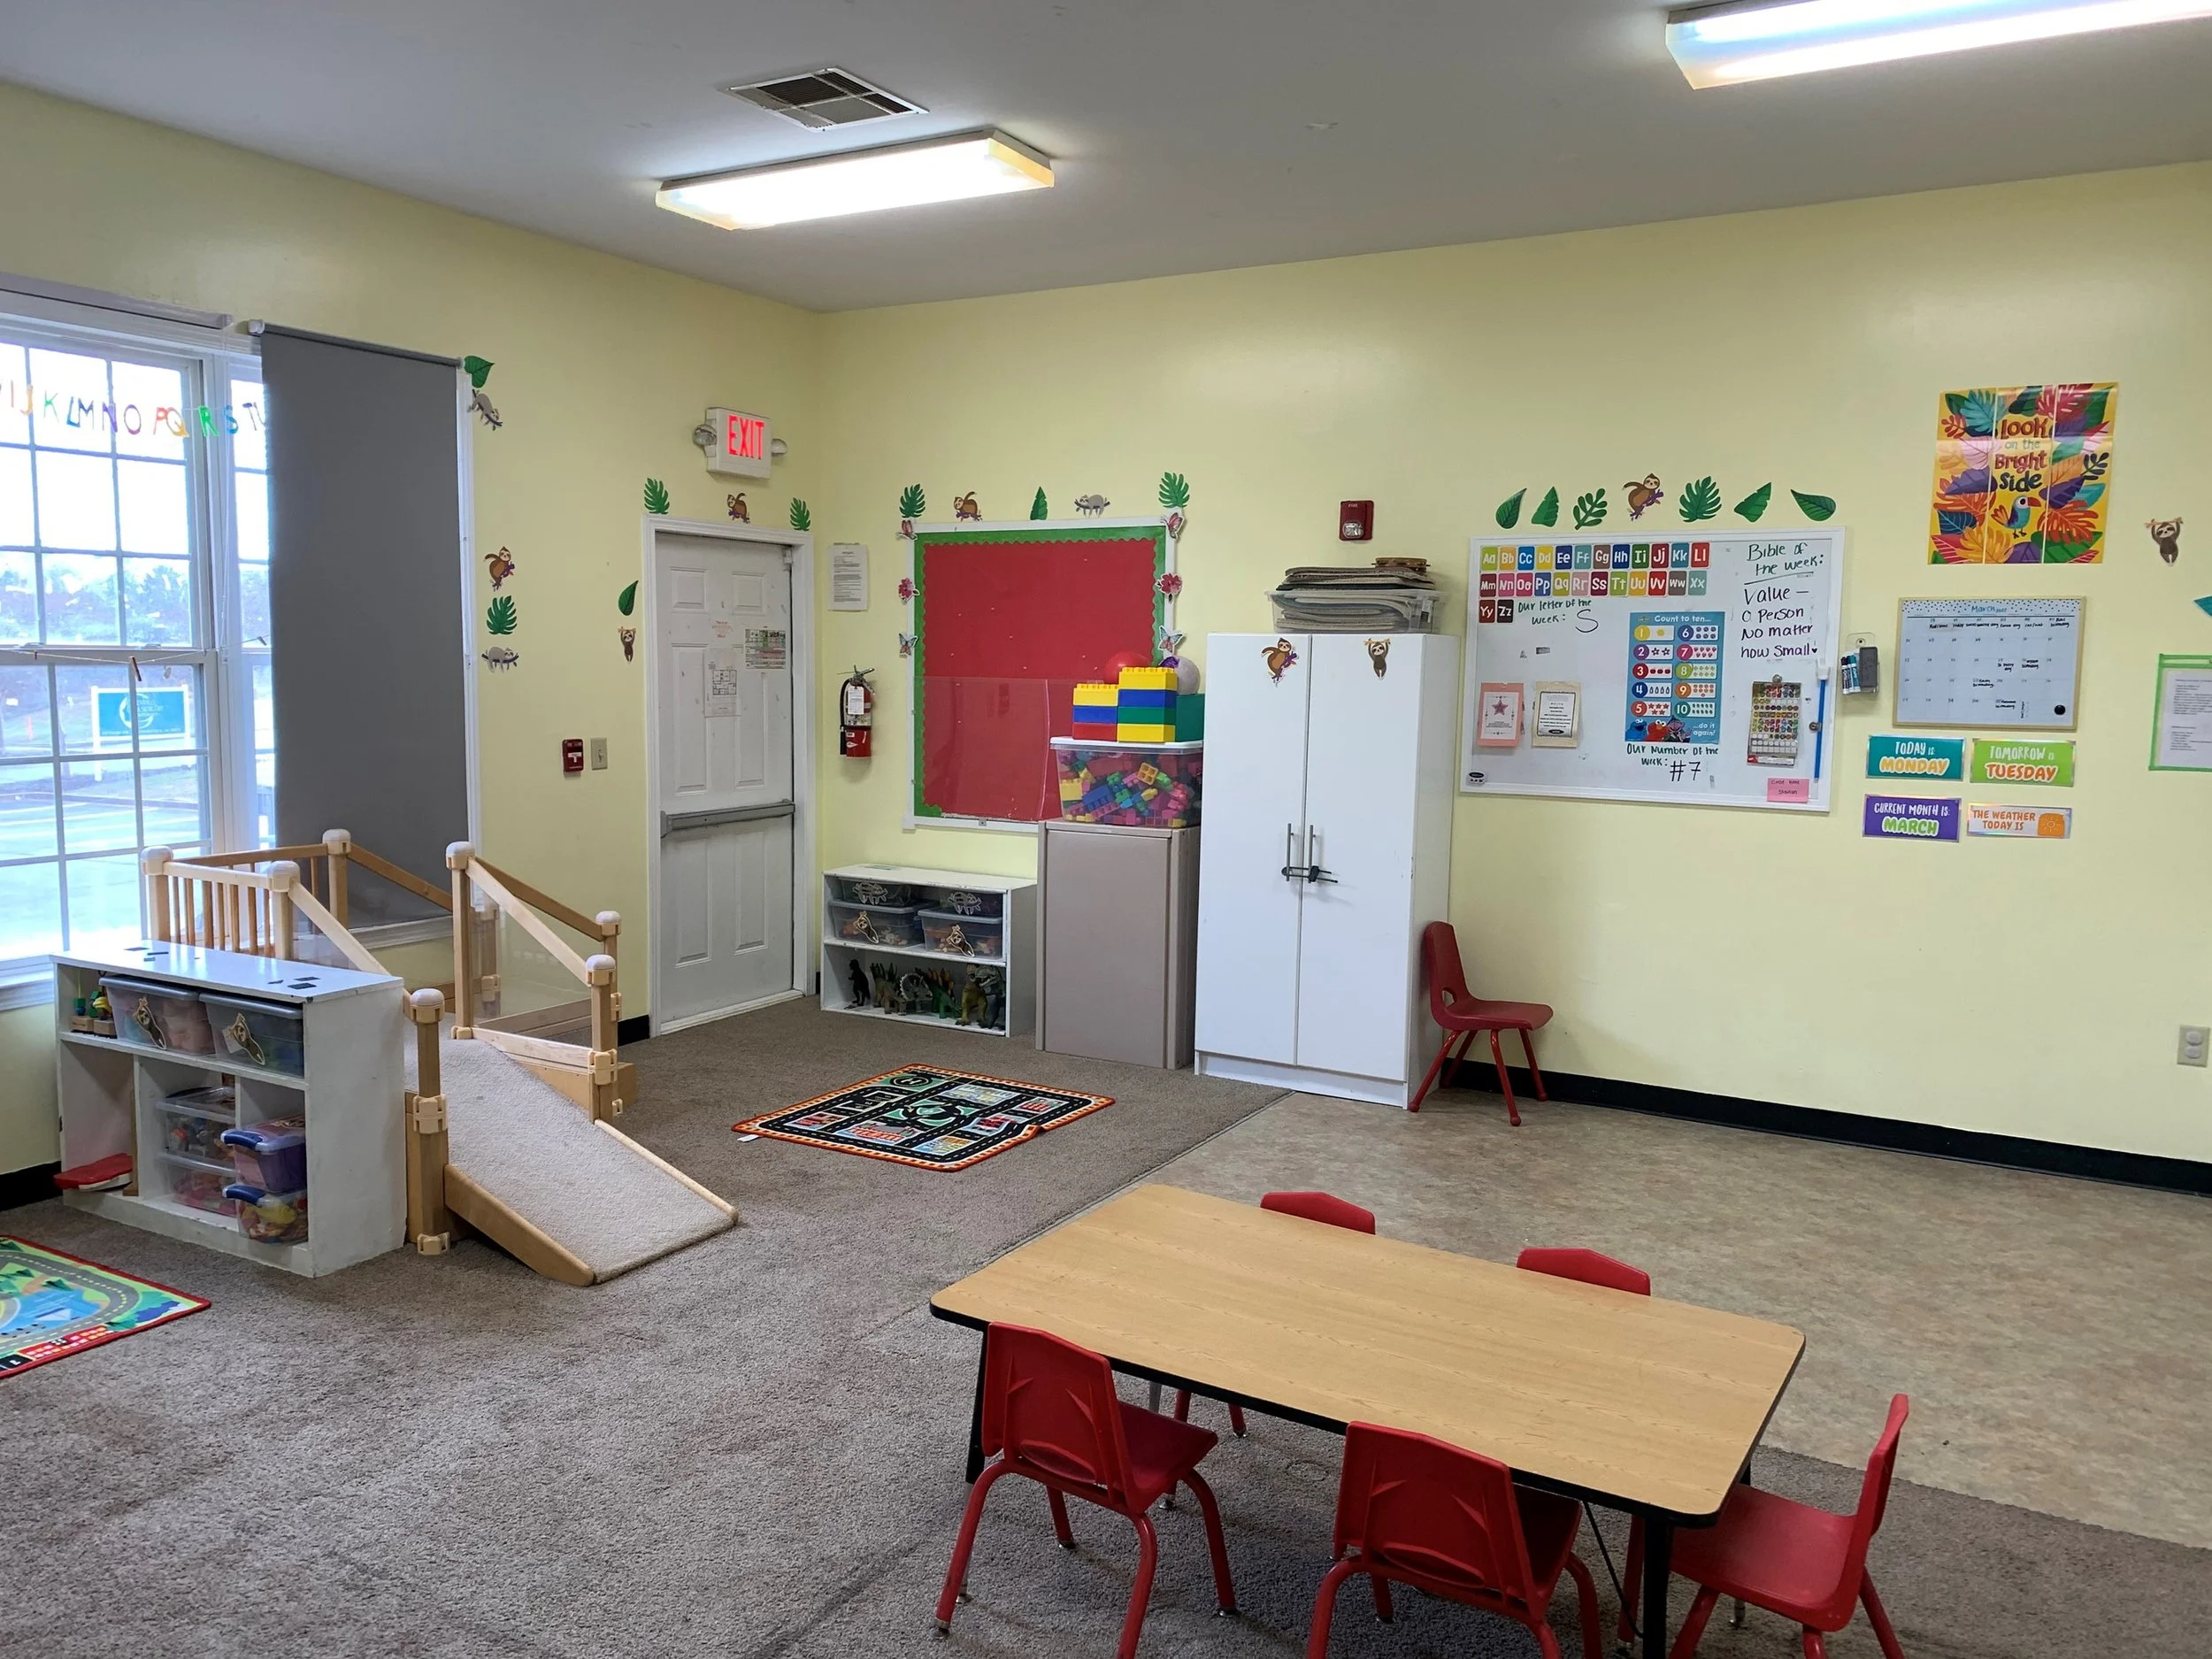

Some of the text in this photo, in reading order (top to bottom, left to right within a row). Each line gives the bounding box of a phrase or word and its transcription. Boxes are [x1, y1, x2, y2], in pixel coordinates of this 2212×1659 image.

[43, 390, 59, 423] K
[66, 396, 81, 428] L
[78, 397, 95, 430] M
[102, 402, 119, 434] N
[123, 404, 142, 435] O
[153, 407, 168, 435] P
[165, 407, 190, 438] Q
[197, 405, 219, 437] R
[223, 404, 239, 434] S
[2001, 418, 2048, 440] Look
[728, 414, 765, 461] EXIT
[2004, 439, 2041, 450] on the
[1994, 449, 2047, 474] Bright
[1999, 470, 2043, 492] Side
[1482, 547, 1706, 565] Aa Bb Cc Dd Ee Ff Gg Hh Ii Jj Kk Ll
[1746, 543, 1786, 561] Bible
[1784, 554, 1824, 571] week:
[1480, 577, 1706, 595] Mm Nn Oo Pp Qq Rr Ss Tt Uu Vv Ww Xx
[1743, 586, 1791, 605] Value
[1480, 605, 1512, 618] Yy Zz
[1540, 600, 1563, 611] letter
[1575, 608, 1599, 634] S
[1682, 627, 1689, 638] 6
[1768, 624, 1814, 637] matter
[1681, 648, 1688, 657] 7
[1741, 646, 1770, 658] how
[1680, 665, 1687, 676] 8
[1679, 685, 1687, 696] 9
[1677, 704, 1687, 715] 10
[1894, 741, 1926, 756] TODAY
[1989, 745, 2046, 760] TOMORROW
[1670, 760, 1701, 781] #7
[1879, 757, 1949, 776] MONDAY
[1985, 763, 2057, 782] TUESDAY
[1873, 803, 1906, 815] CURRENT
[1909, 803, 1939, 816] MONTH
[1972, 810, 2036, 821] THE WEATHER
[1882, 817, 1939, 835] MARCH
[1982, 820, 2024, 831] TODAY IS
